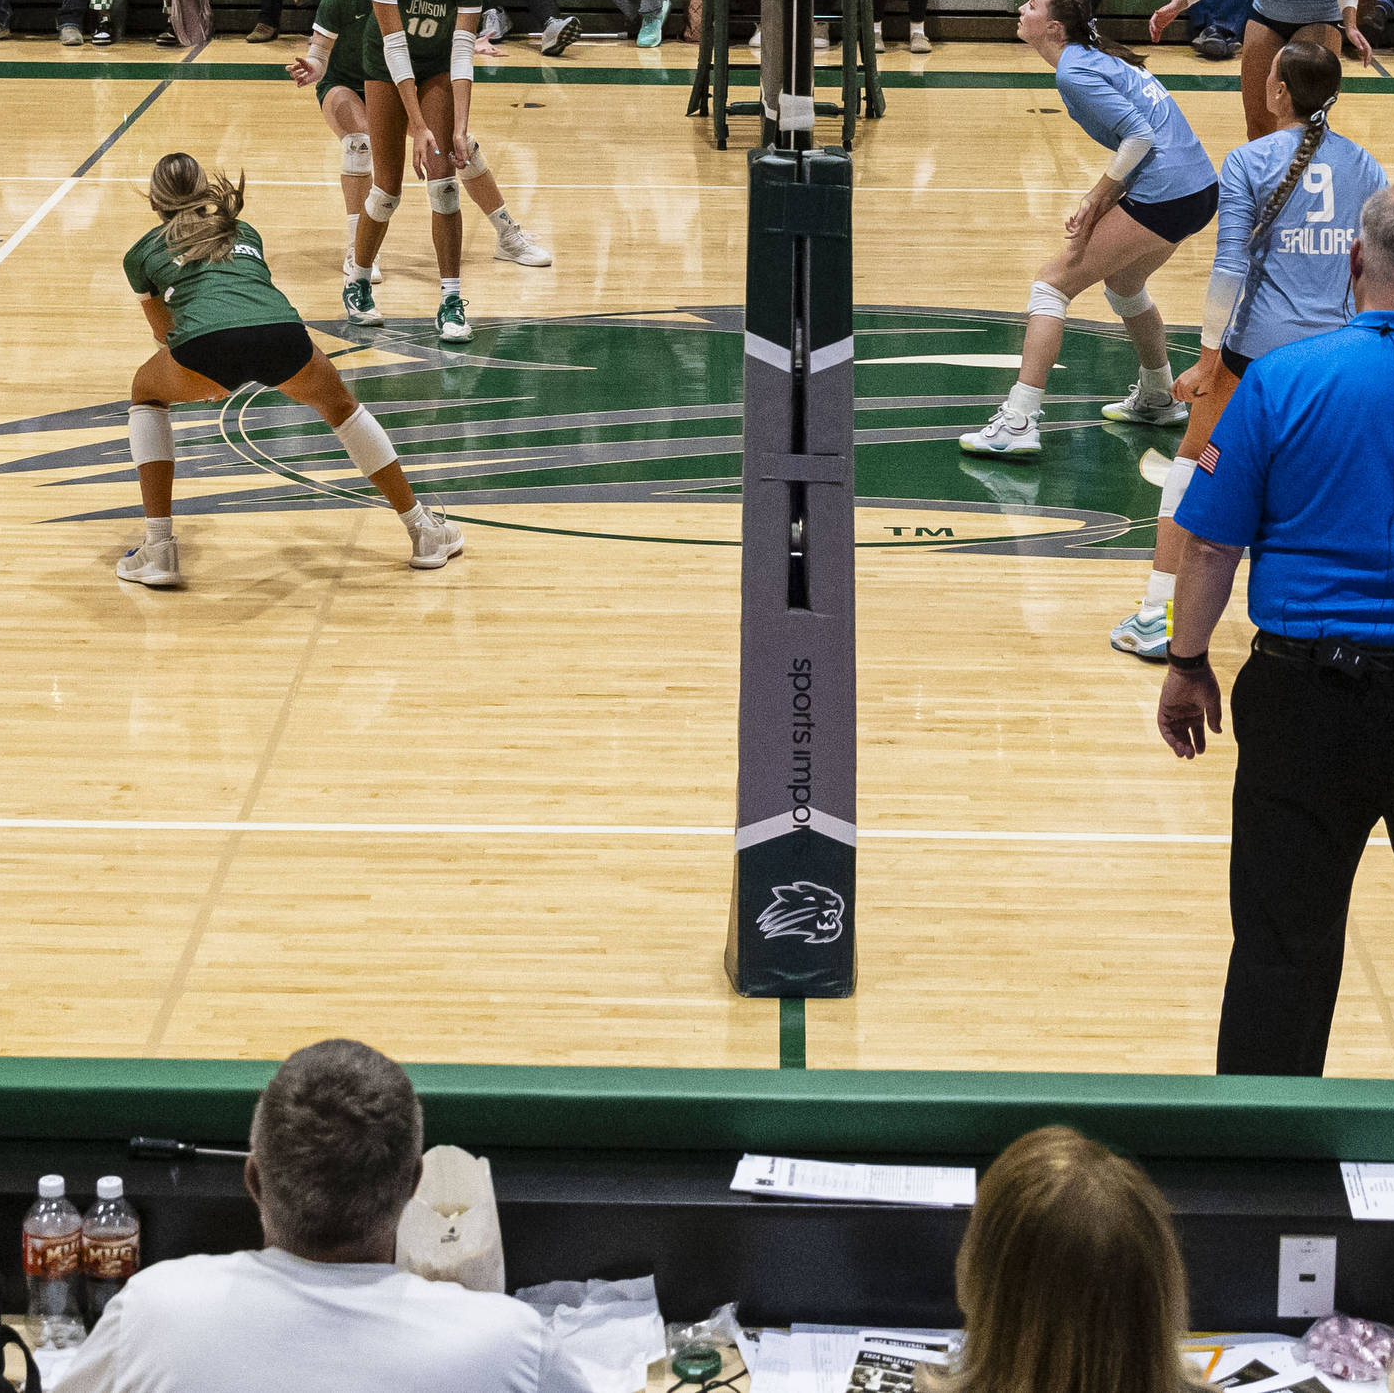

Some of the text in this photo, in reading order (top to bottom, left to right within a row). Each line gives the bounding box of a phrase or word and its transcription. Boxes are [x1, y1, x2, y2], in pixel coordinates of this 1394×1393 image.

[406, 0, 447, 18] JENISON
[407, 17, 439, 39] 10
[1302, 162, 1335, 223] 9
[1277, 228, 1355, 256] SAILORS
[883, 526, 954, 537] TM
[787, 658, 816, 744] sports
[88, 1246, 133, 1263] MUG
[882, 1354, 915, 1368] VOLLEYBA
